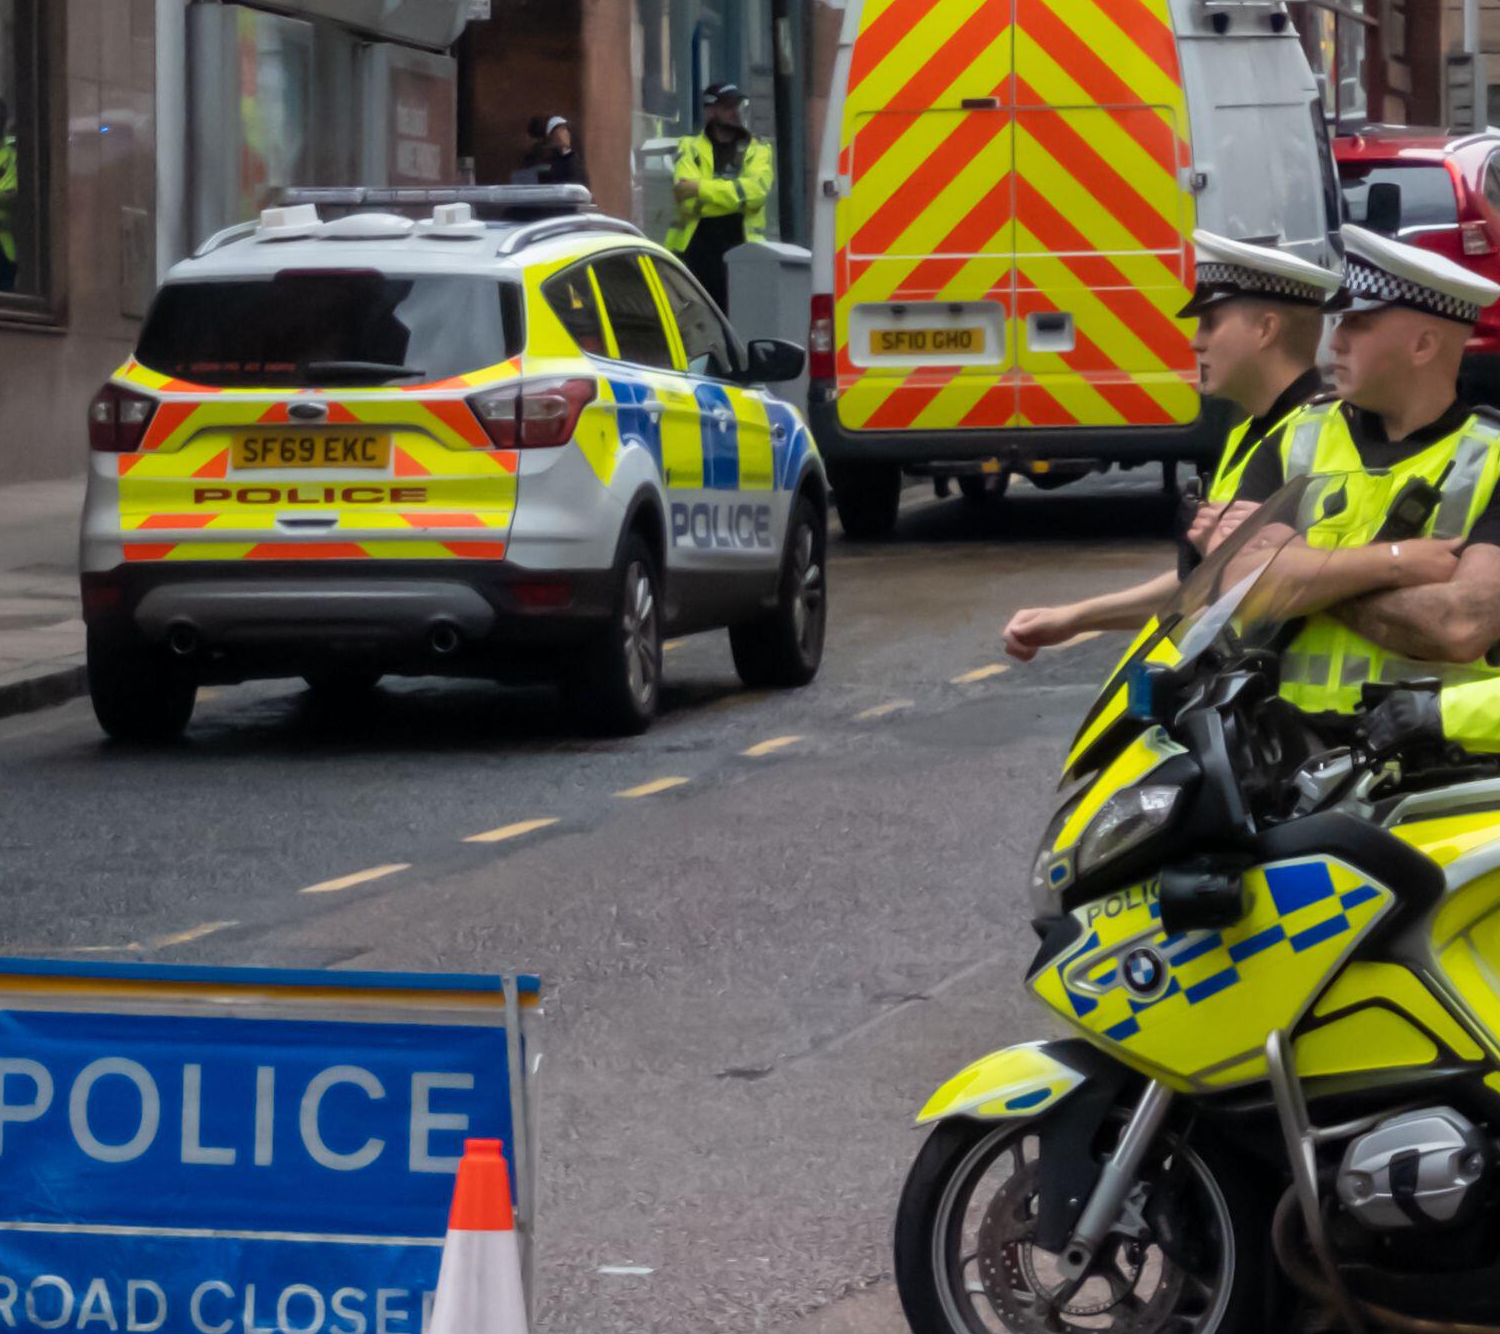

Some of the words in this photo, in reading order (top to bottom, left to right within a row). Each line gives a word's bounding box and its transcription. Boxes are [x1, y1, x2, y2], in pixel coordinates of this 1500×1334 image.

[881, 331, 926, 350] SF10
[243, 437, 317, 463] SF69
[324, 437, 378, 463] EKC
[193, 487, 428, 505] POLICE
[670, 502, 773, 549] POLICE
[1086, 876, 1161, 928] POLIC
